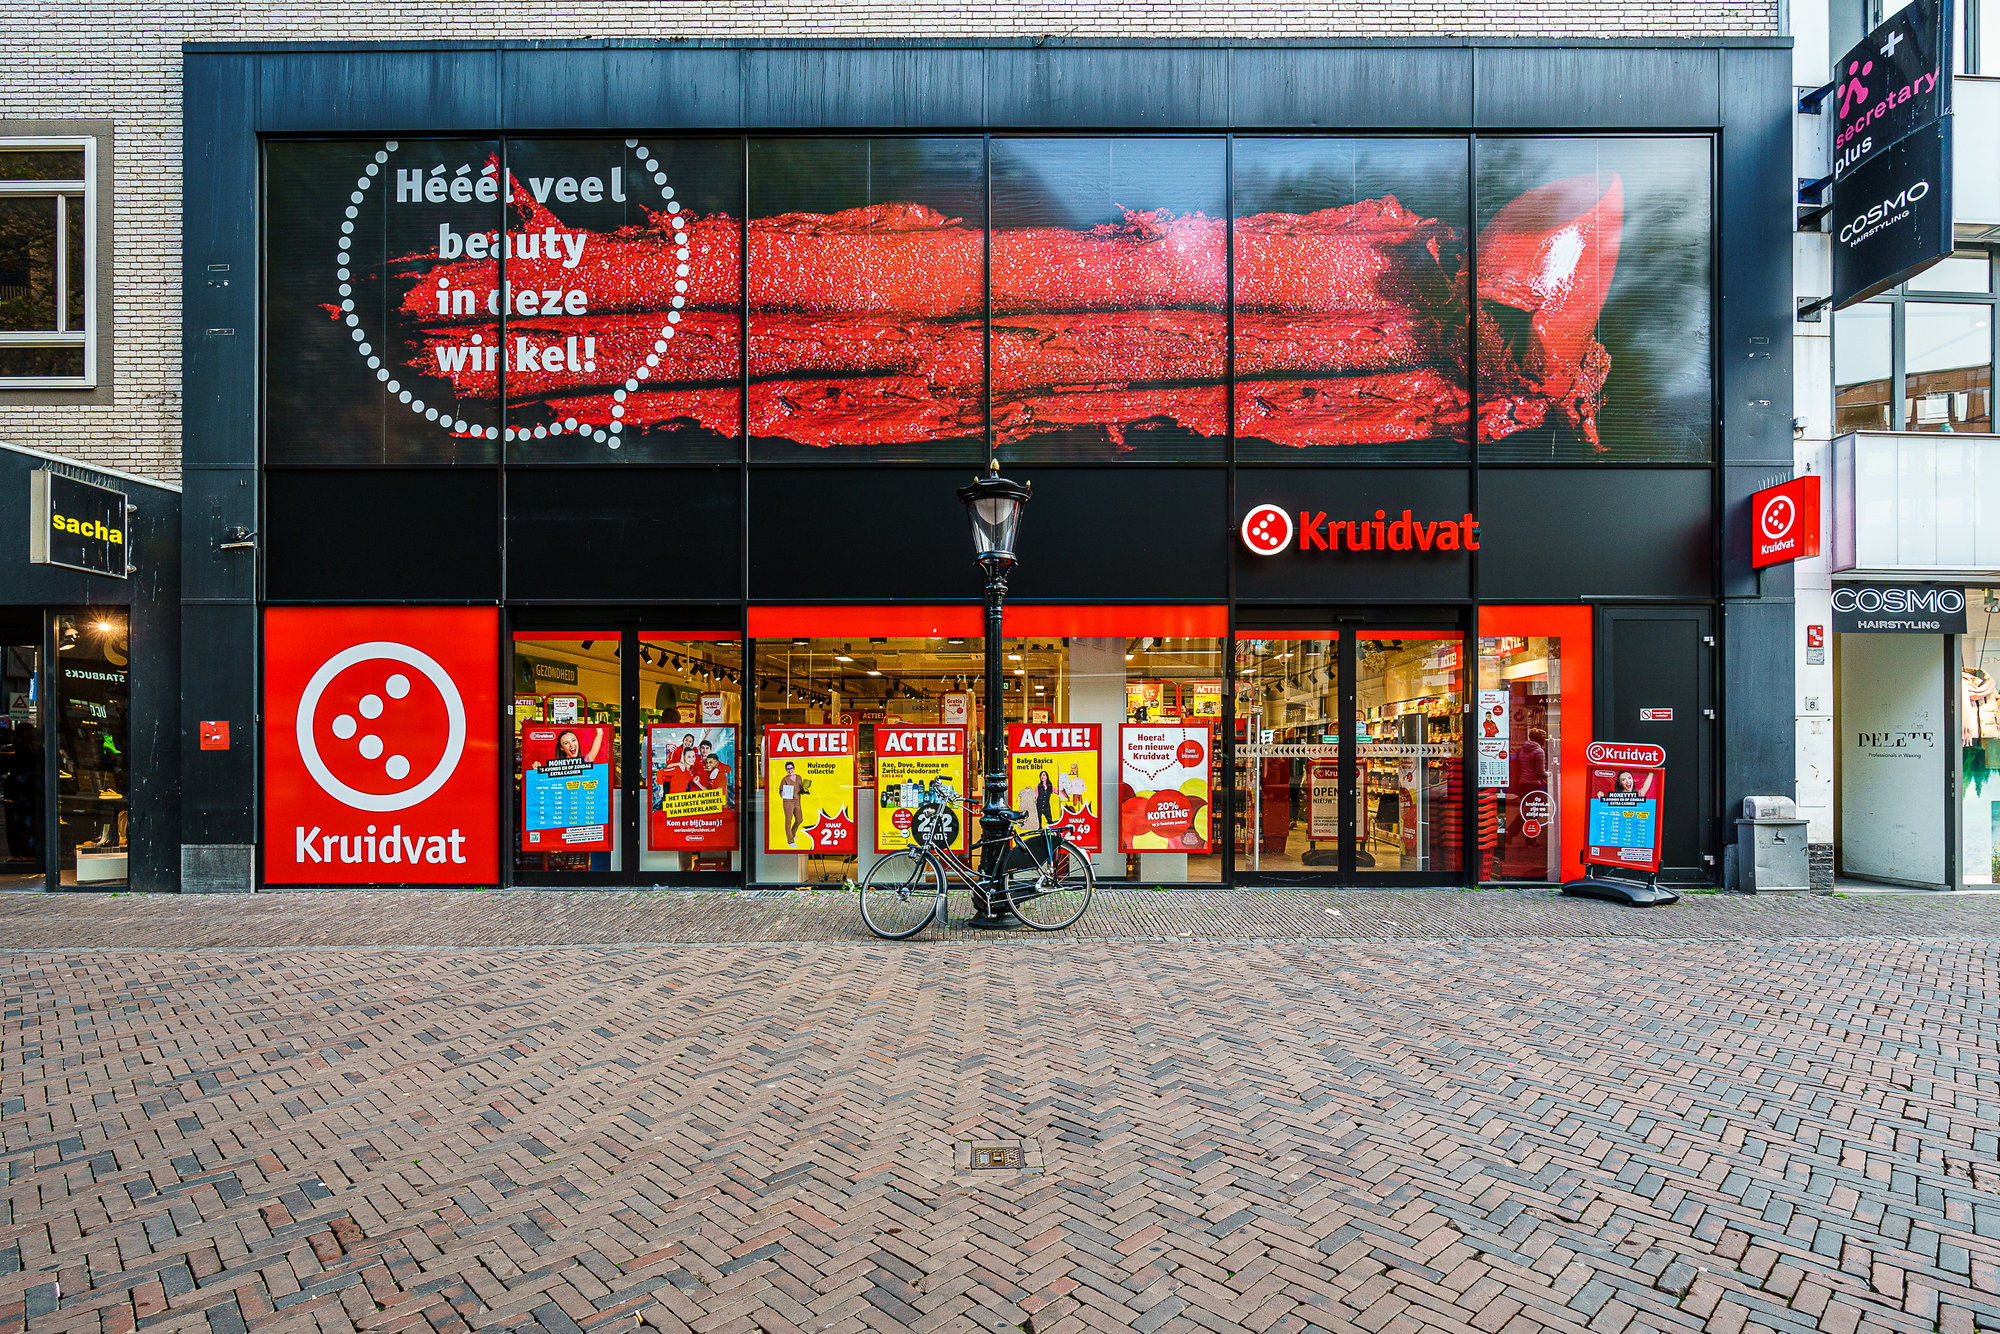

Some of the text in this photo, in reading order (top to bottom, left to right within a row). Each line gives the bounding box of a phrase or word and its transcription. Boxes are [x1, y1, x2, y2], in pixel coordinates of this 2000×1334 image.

[1836, 66, 1940, 150] secretary
[1835, 136, 1872, 181] plus
[396, 164, 627, 203] Hééél veel
[1839, 181, 1930, 242] COSMO
[1850, 209, 1911, 248] HAIRSTYLING
[438, 223, 587, 268] beauty
[435, 278, 588, 316] in deze
[435, 334, 596, 373] winkel!
[53, 514, 123, 544] sacha
[1300, 509, 1480, 551] Kruidvat
[1761, 538, 1795, 555] Kruidvat
[1830, 588, 1965, 613] COSMO
[1857, 620, 1940, 630] HAIRSTYLING
[536, 664, 575, 681] GEZONDHEID
[1810, 701, 1815, 709] 8
[776, 732, 848, 753] ACTIE!
[884, 732, 957, 752] ACTIE!
[1019, 728, 1091, 748] ACTIE!
[1137, 733, 1165, 741] Hoera!
[548, 758, 582, 767] MONEYYY!
[1133, 752, 1170, 760] Kruidvat
[1605, 747, 1658, 762] Kruidvat
[1313, 787, 1361, 797] OPENG
[1157, 801, 1179, 811] 20%
[690, 819, 723, 828] bij(baan)!
[918, 813, 952, 832] 22
[296, 824, 467, 865] Kruidvat
[820, 829, 847, 845] 2.99
